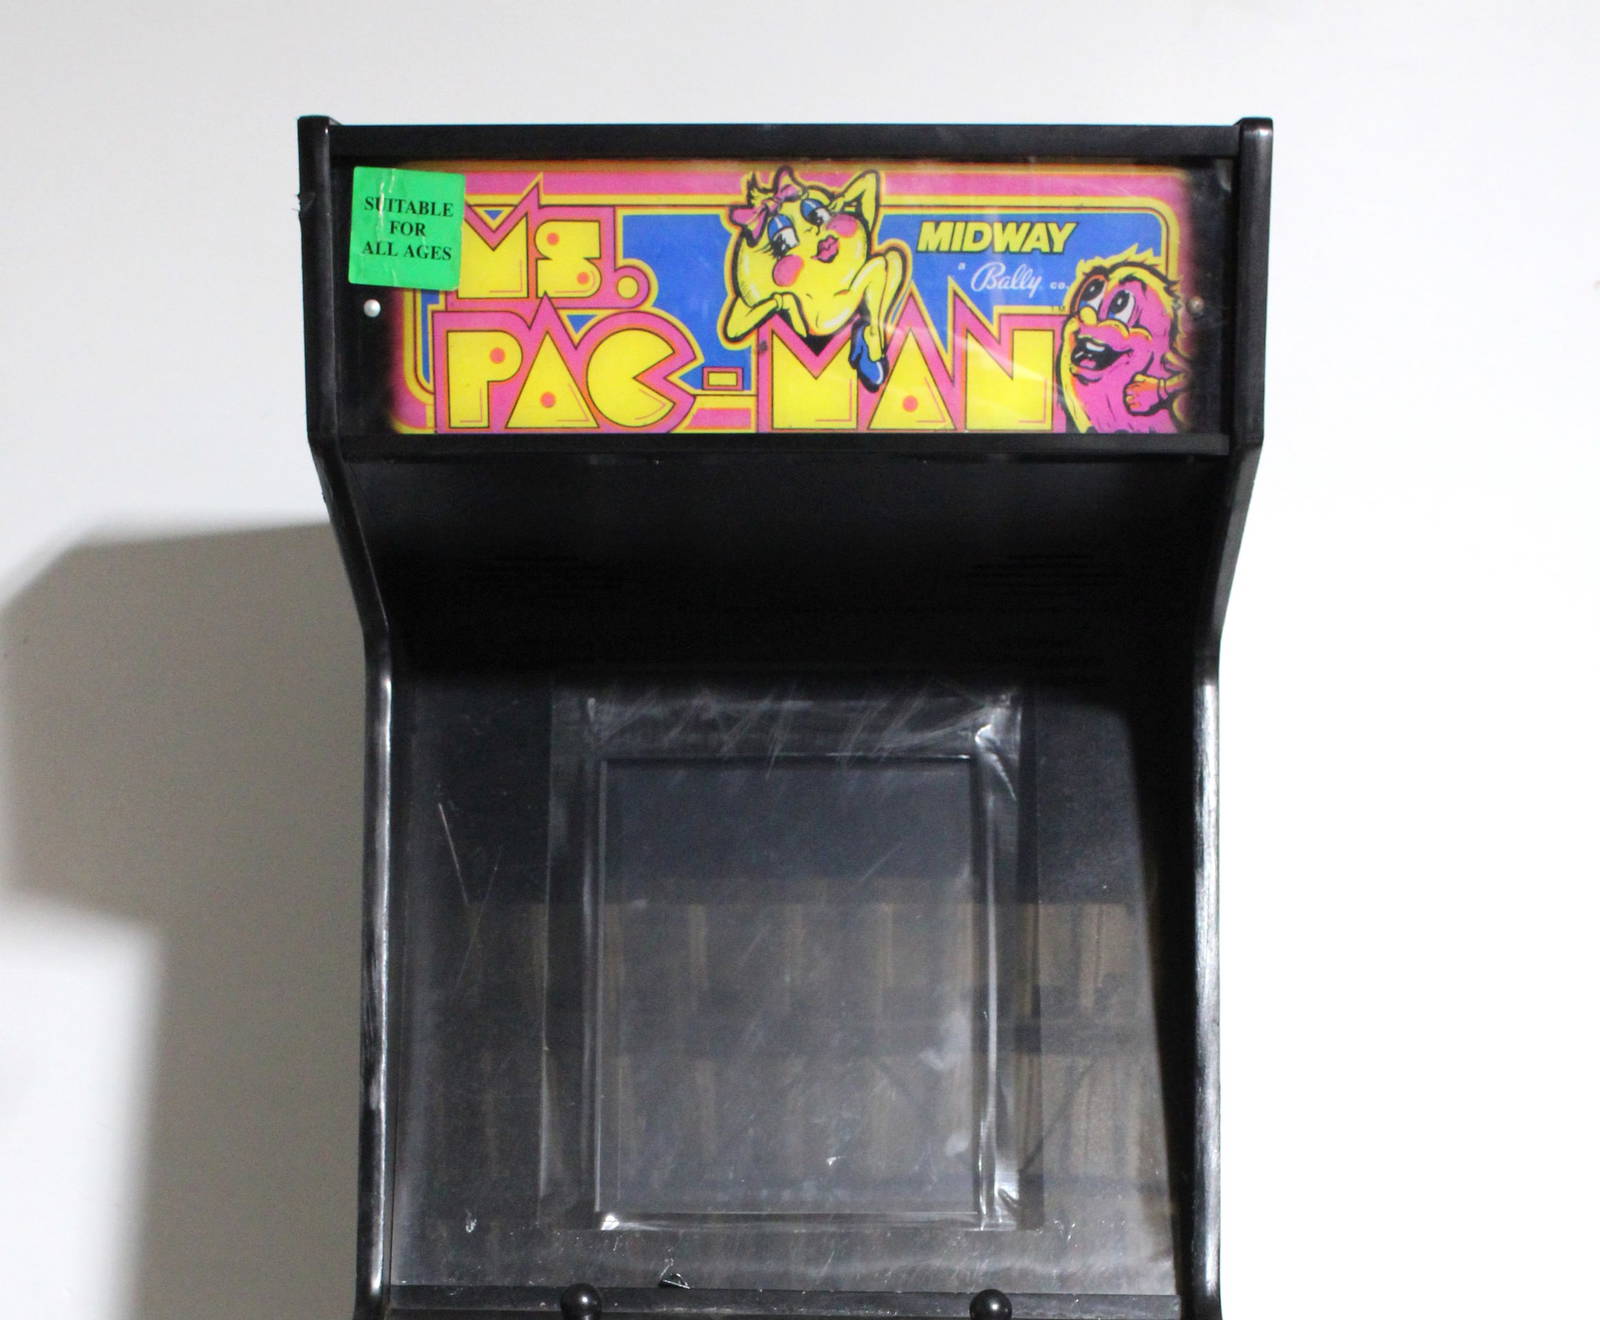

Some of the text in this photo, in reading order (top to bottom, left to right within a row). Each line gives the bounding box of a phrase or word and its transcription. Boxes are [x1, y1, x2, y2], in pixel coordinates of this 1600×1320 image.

[364, 196, 455, 217] SUITABLE
[389, 220, 426, 237] FOR
[916, 221, 1078, 254] MIDWAY
[362, 241, 452, 261] ALL AGES
[970, 261, 1043, 299] Bally
[442, 316, 1058, 430] PAC-MAN
